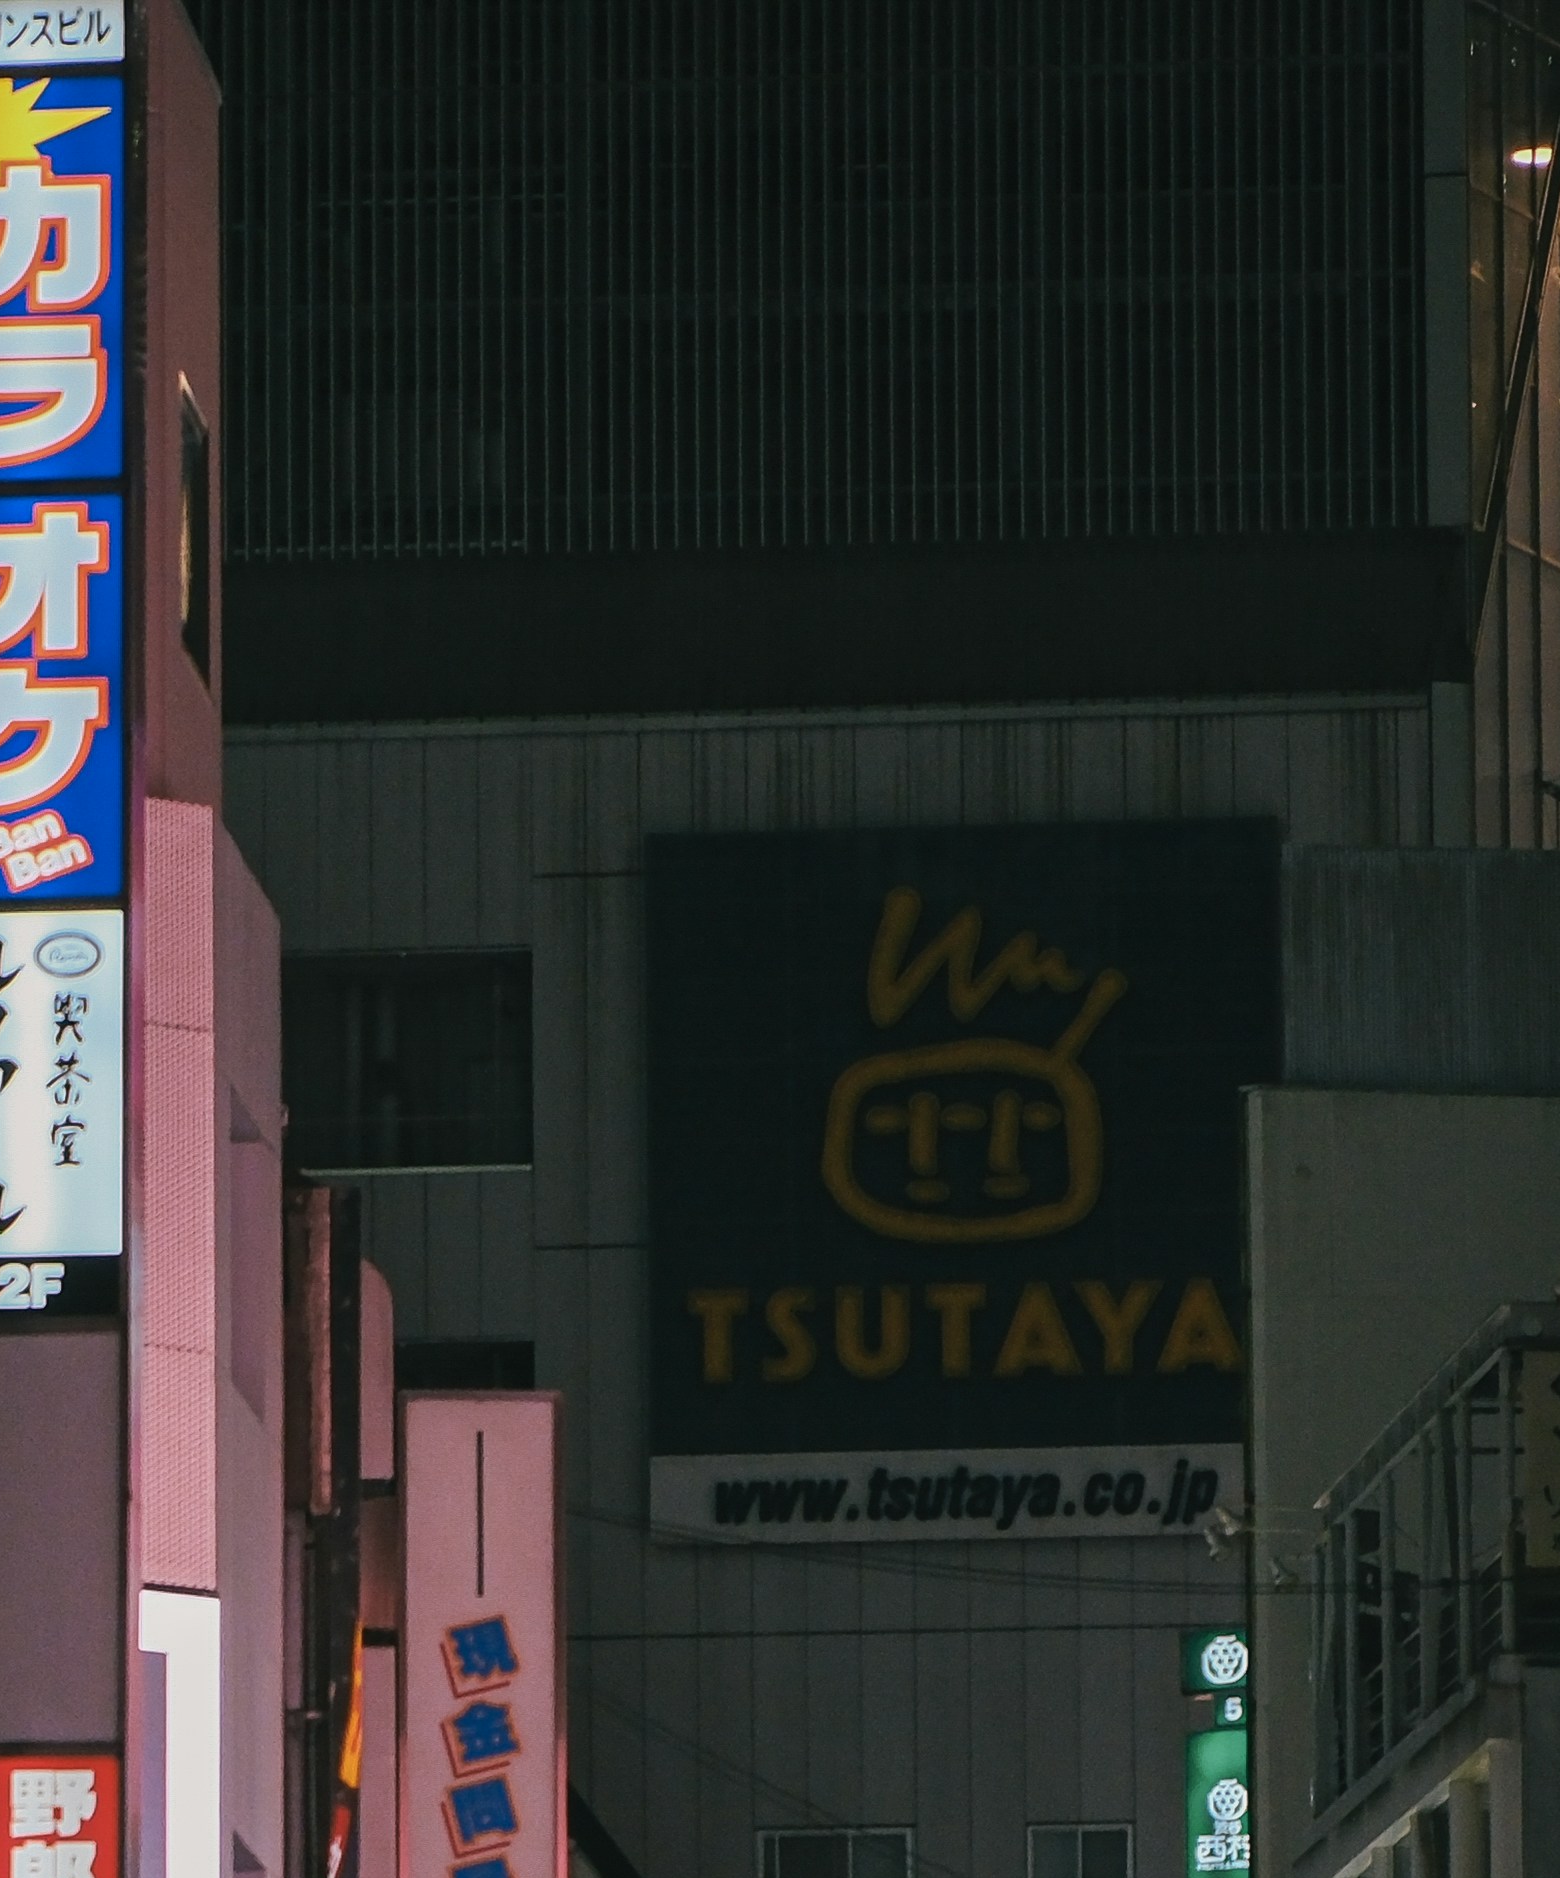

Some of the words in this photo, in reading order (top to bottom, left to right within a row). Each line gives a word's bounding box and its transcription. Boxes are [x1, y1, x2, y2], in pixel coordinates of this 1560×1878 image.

[9, 838, 90, 889] Ban
[688, 1277, 1243, 1384] TSUTAYA
[712, 1459, 1220, 1530] www.tsutaya.co.jp
[1224, 1696, 1244, 1722] 5
